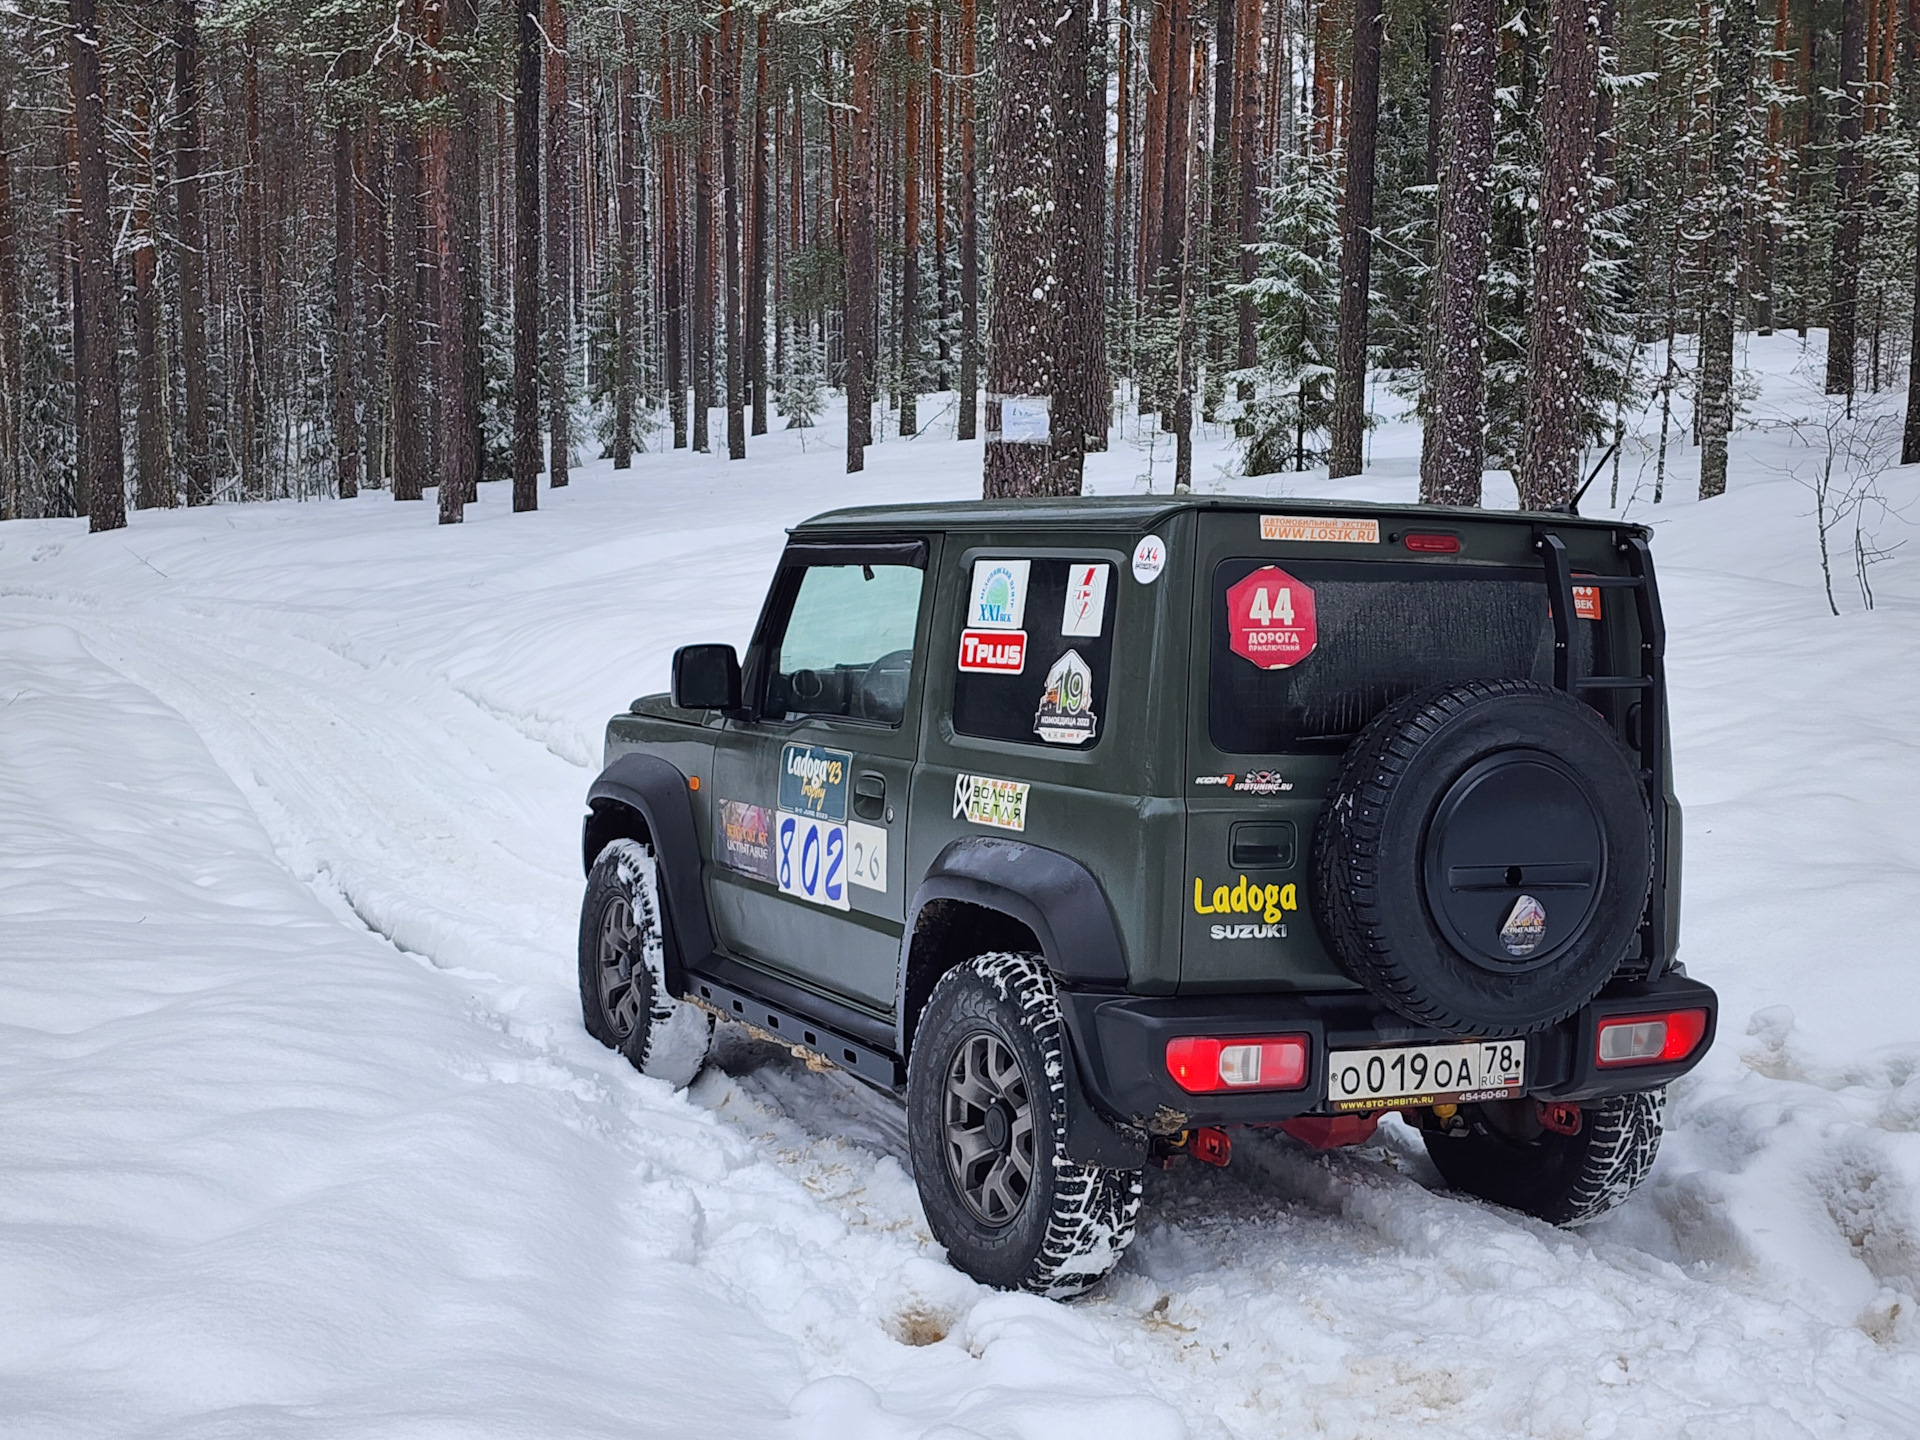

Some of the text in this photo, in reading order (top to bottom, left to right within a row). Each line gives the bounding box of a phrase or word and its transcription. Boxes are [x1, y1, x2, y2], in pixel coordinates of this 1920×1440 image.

[1264, 517, 1377, 529] АВТОМОБИЛЬНЫЙ ЭКСТРИМ
[1263, 526, 1376, 542] WWW.LOSIK.RU
[977, 603, 1000, 621] XXI
[1249, 587, 1295, 626] 44
[1248, 632, 1300, 645] ДОРОГА
[1248, 643, 1300, 652] ПРИКЛЮЧЕНИЙ
[1054, 670, 1084, 716] 19
[973, 785, 1023, 805] ВОЛЧЬЯ
[1233, 781, 1293, 791] SPBTUNING.RU
[971, 801, 1021, 820] ПЕТЛЯ
[780, 817, 844, 901] 802
[854, 842, 880, 881] 26
[1193, 874, 1298, 924] Ladoga
[1210, 924, 1288, 940] SUZUKI
[1484, 1045, 1512, 1074] 78
[1481, 1074, 1503, 1087] RUS
[1340, 1089, 1508, 1111] WWW.STO-ORBITA.RU 454-60-60
